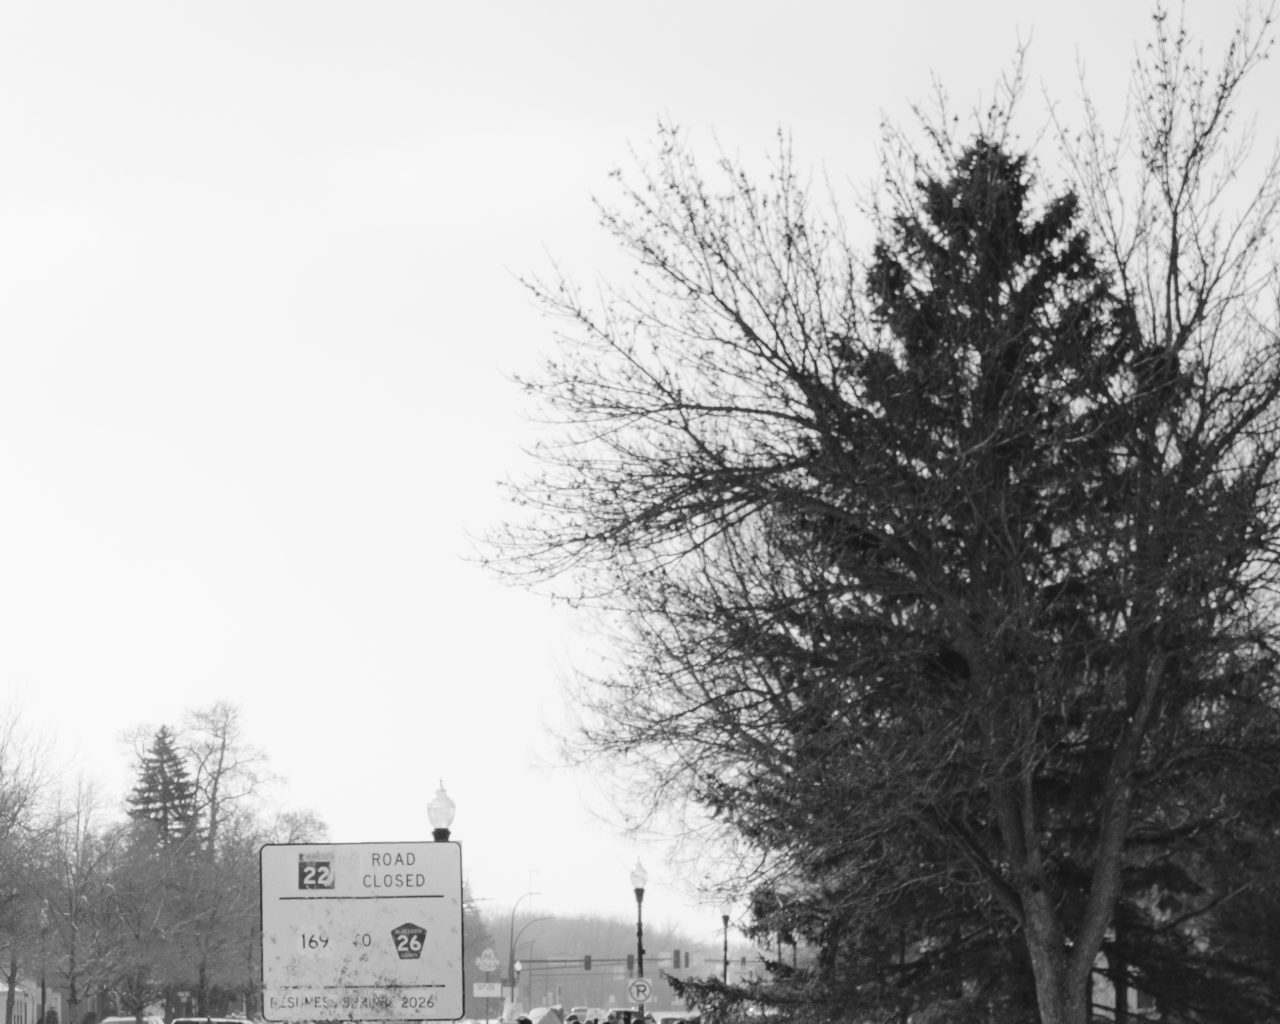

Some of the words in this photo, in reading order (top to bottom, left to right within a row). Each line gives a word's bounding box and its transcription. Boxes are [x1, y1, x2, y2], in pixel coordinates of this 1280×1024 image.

[372, 853, 416, 866] ROAD
[303, 866, 329, 885] 22
[363, 874, 426, 888] CLOSED
[301, 934, 329, 949] 169
[397, 935, 421, 951] 26
[401, 995, 435, 1009] 2026
